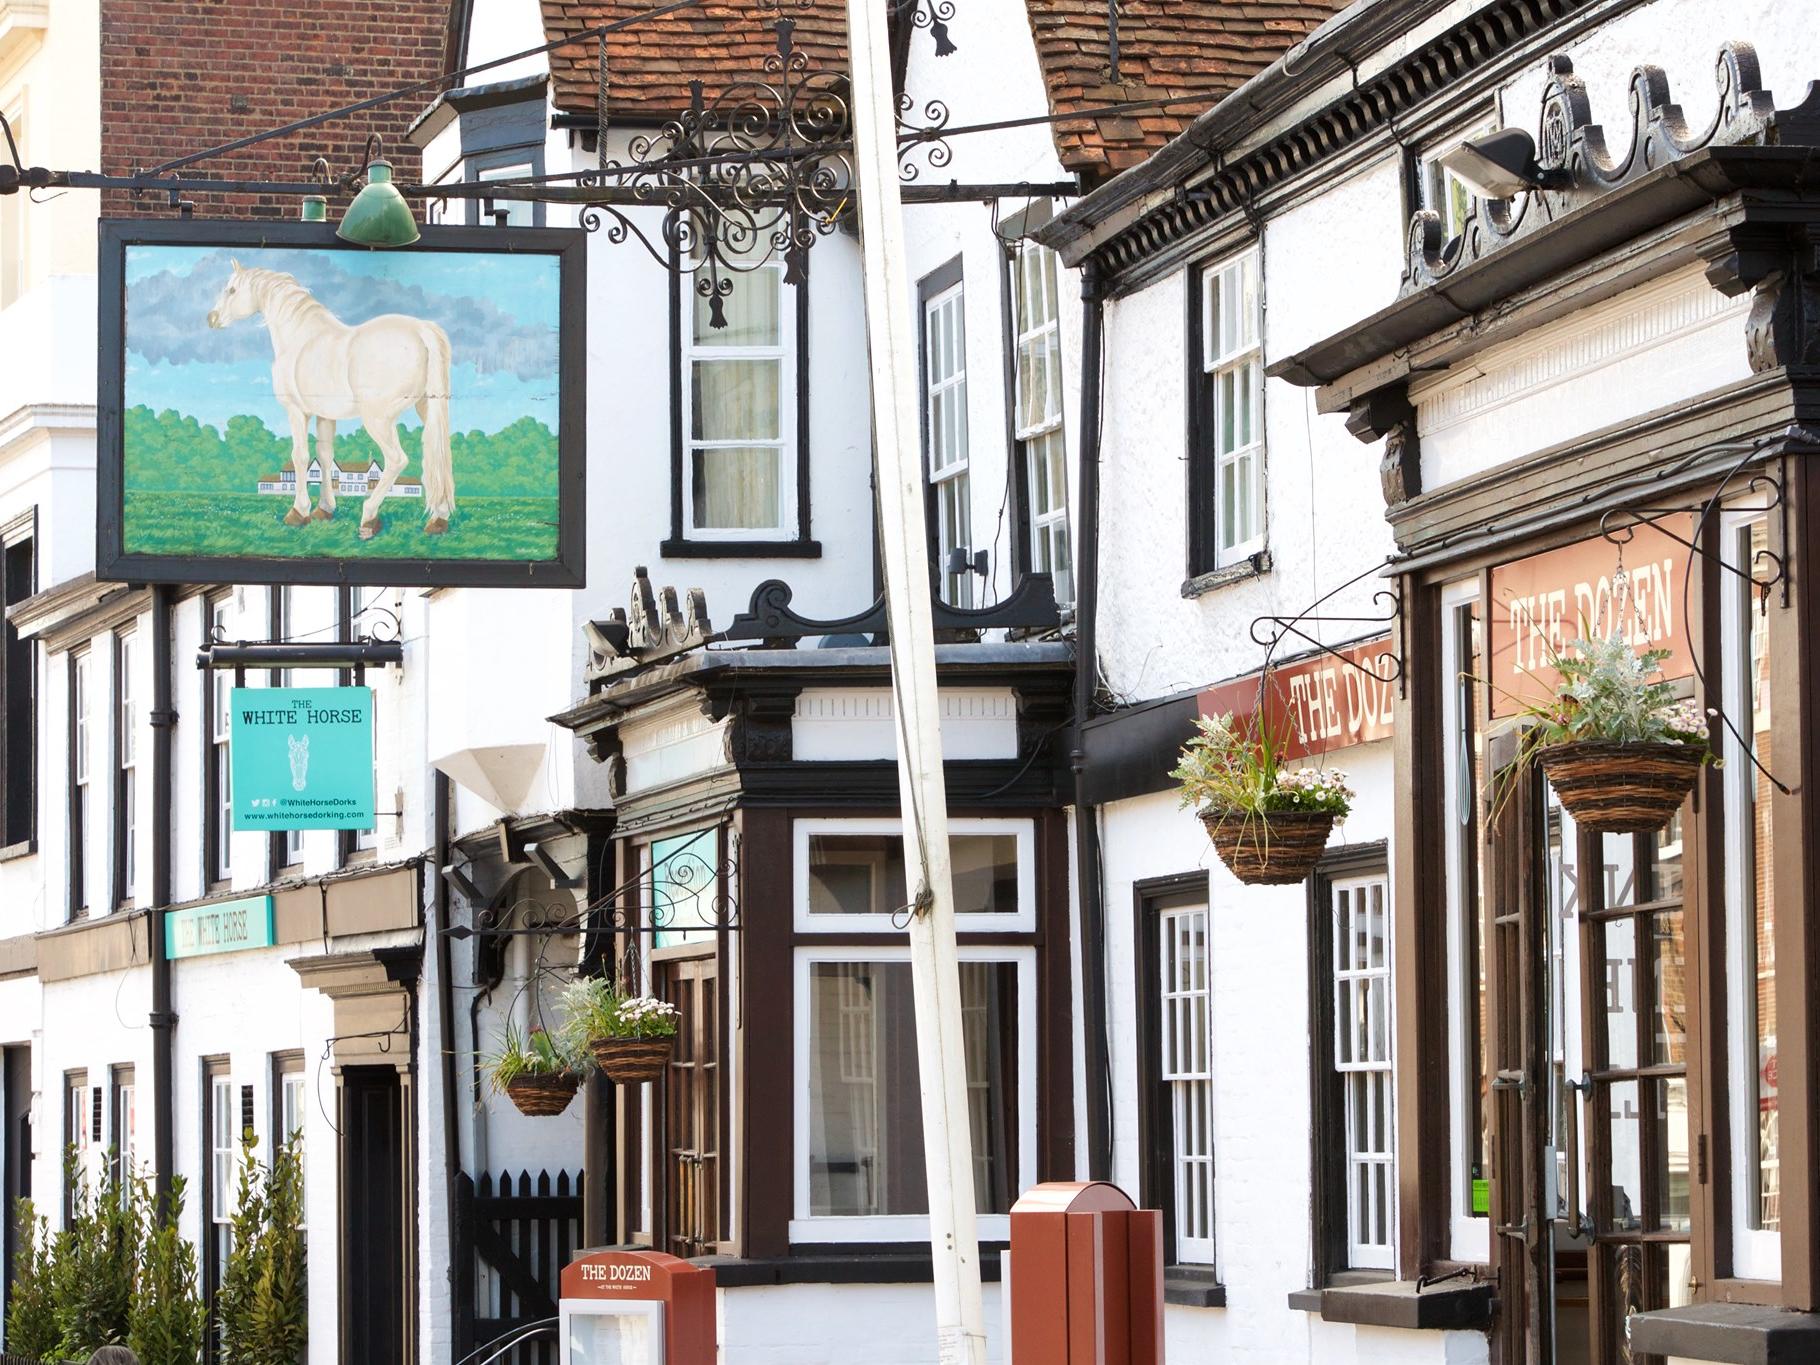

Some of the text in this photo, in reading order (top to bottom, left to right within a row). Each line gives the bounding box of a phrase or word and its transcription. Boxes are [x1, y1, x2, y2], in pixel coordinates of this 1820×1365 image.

[1510, 558, 1673, 674] THE DOZEN
[291, 699, 313, 709] THE
[1290, 653, 1394, 744] THE DOZ
[242, 709, 363, 725] WHITE HORSE
[280, 798, 357, 807] @WhiteHorseDorks
[244, 811, 365, 820] www.whitehorsedorking.com
[197, 914, 221, 945] WHITE
[223, 909, 248, 943] HORSE
[581, 1264, 651, 1281] THE DOZEN
